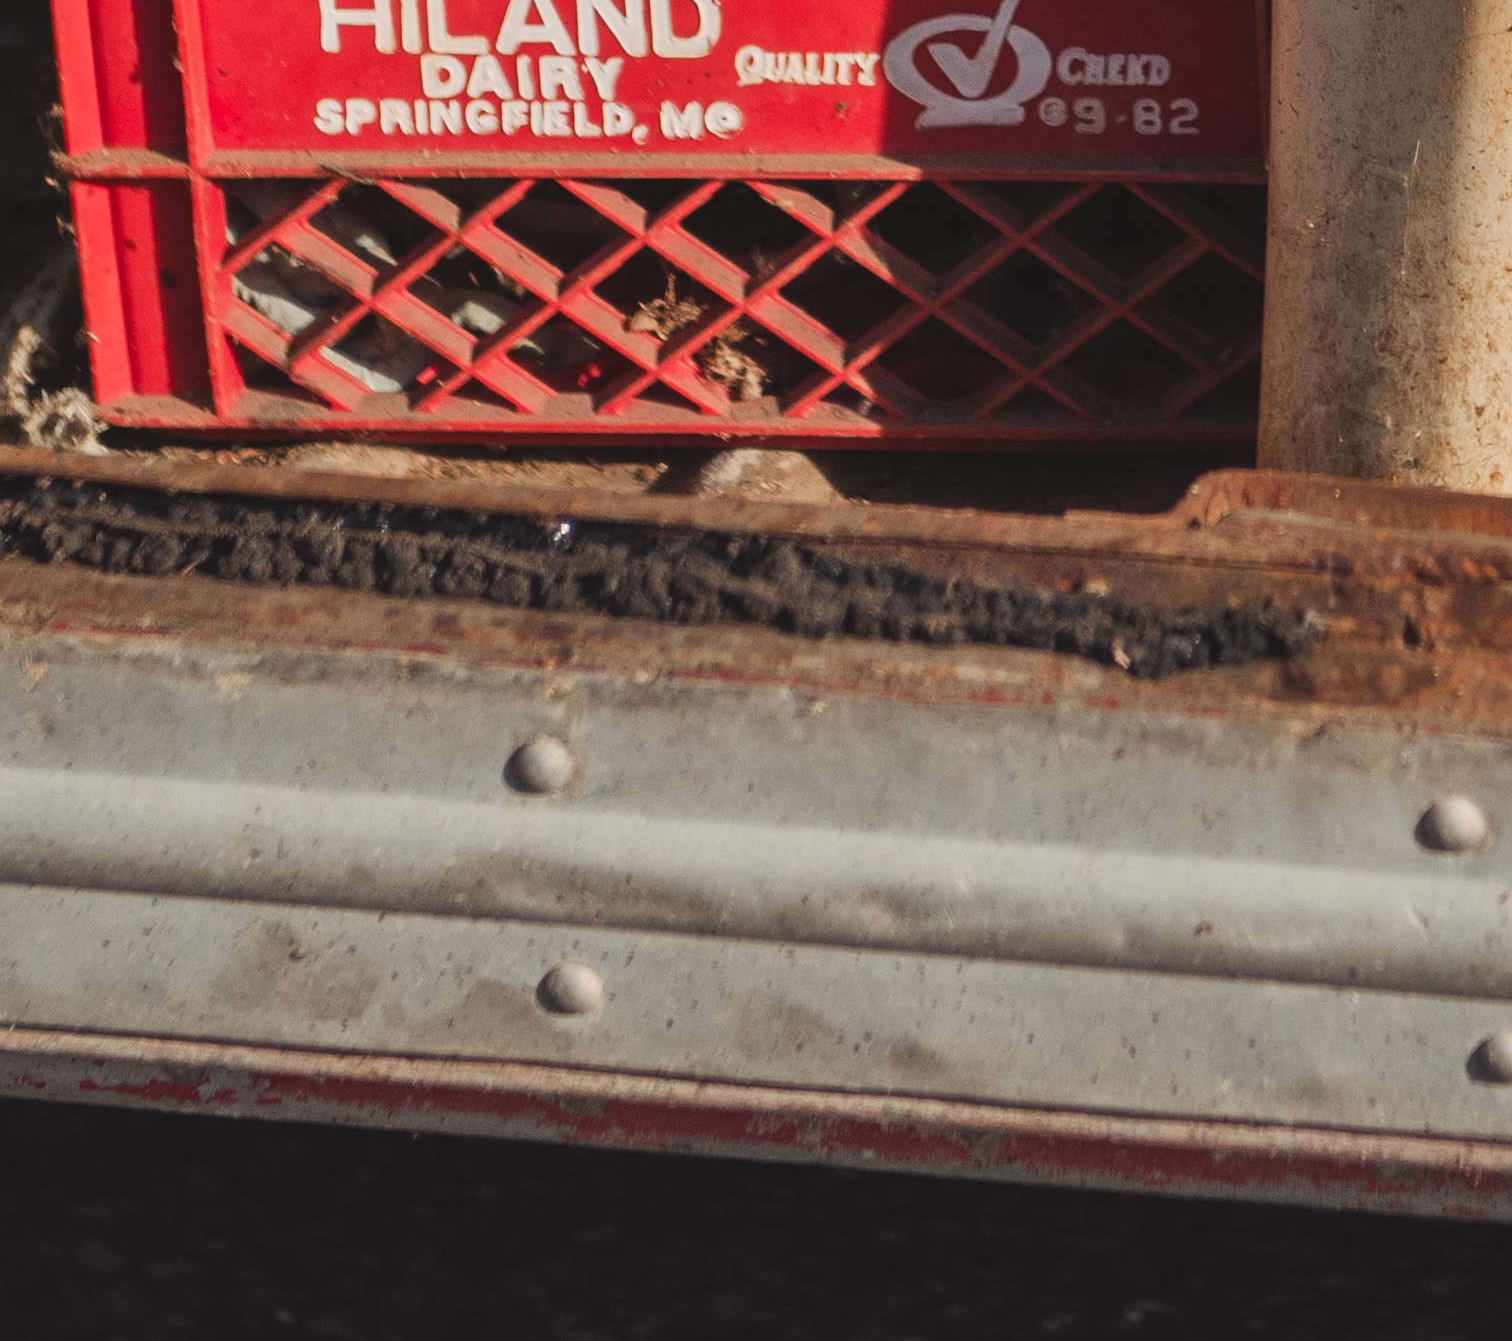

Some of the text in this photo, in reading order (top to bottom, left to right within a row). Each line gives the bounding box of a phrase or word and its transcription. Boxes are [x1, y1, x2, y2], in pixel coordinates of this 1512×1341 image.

[421, 55, 624, 101] DAIRY
[734, 44, 880, 87] QUALITY
[313, 97, 745, 146] SPRINGFIELD, MO
